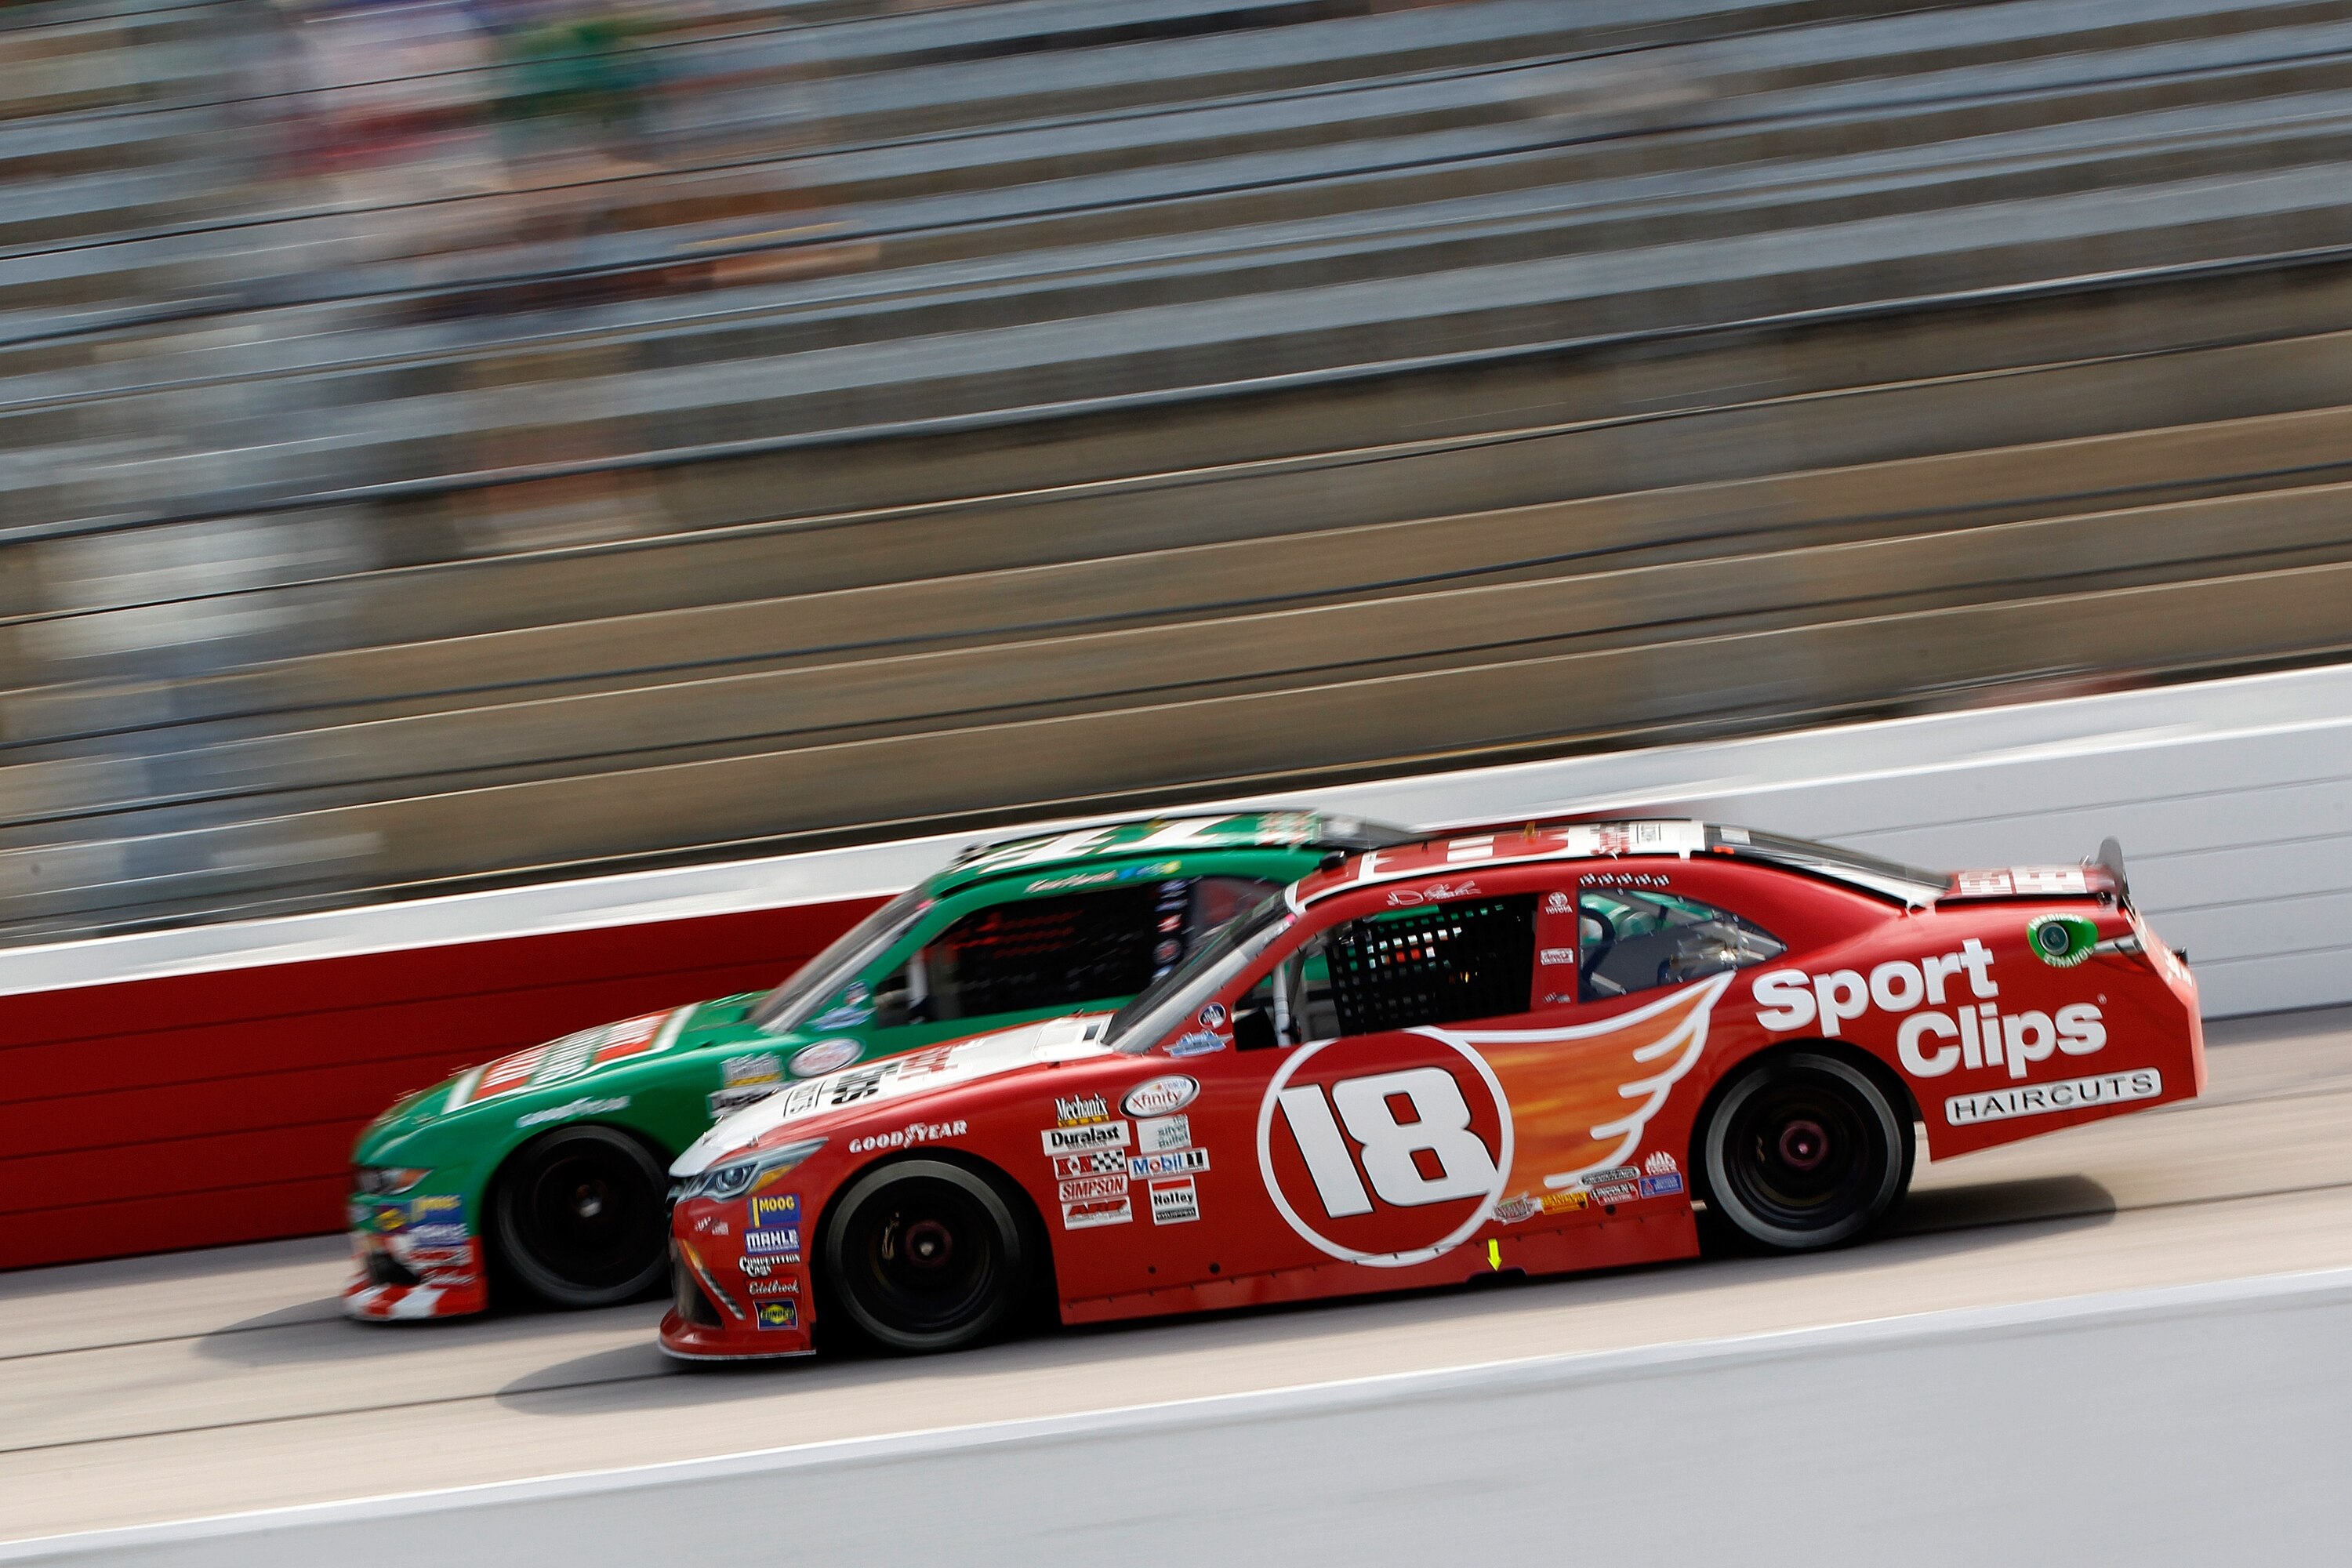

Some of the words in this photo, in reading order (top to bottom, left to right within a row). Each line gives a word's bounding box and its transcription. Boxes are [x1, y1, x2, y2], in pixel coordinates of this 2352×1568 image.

[1751, 938, 1999, 1038] Sport
[1896, 1002, 2107, 1080] Clips
[1955, 1073, 2154, 1122] HAIRCUTS
[1051, 1125, 1120, 1146] Duralast
[1278, 1067, 1498, 1218] 18
[1133, 1153, 1182, 1175] Mobil
[1062, 1177, 1123, 1198] SIMPSON
[759, 1196, 795, 1213] MOOG
[746, 1229, 798, 1250] MAHLE
[749, 1279, 799, 1295] Edelbrock
